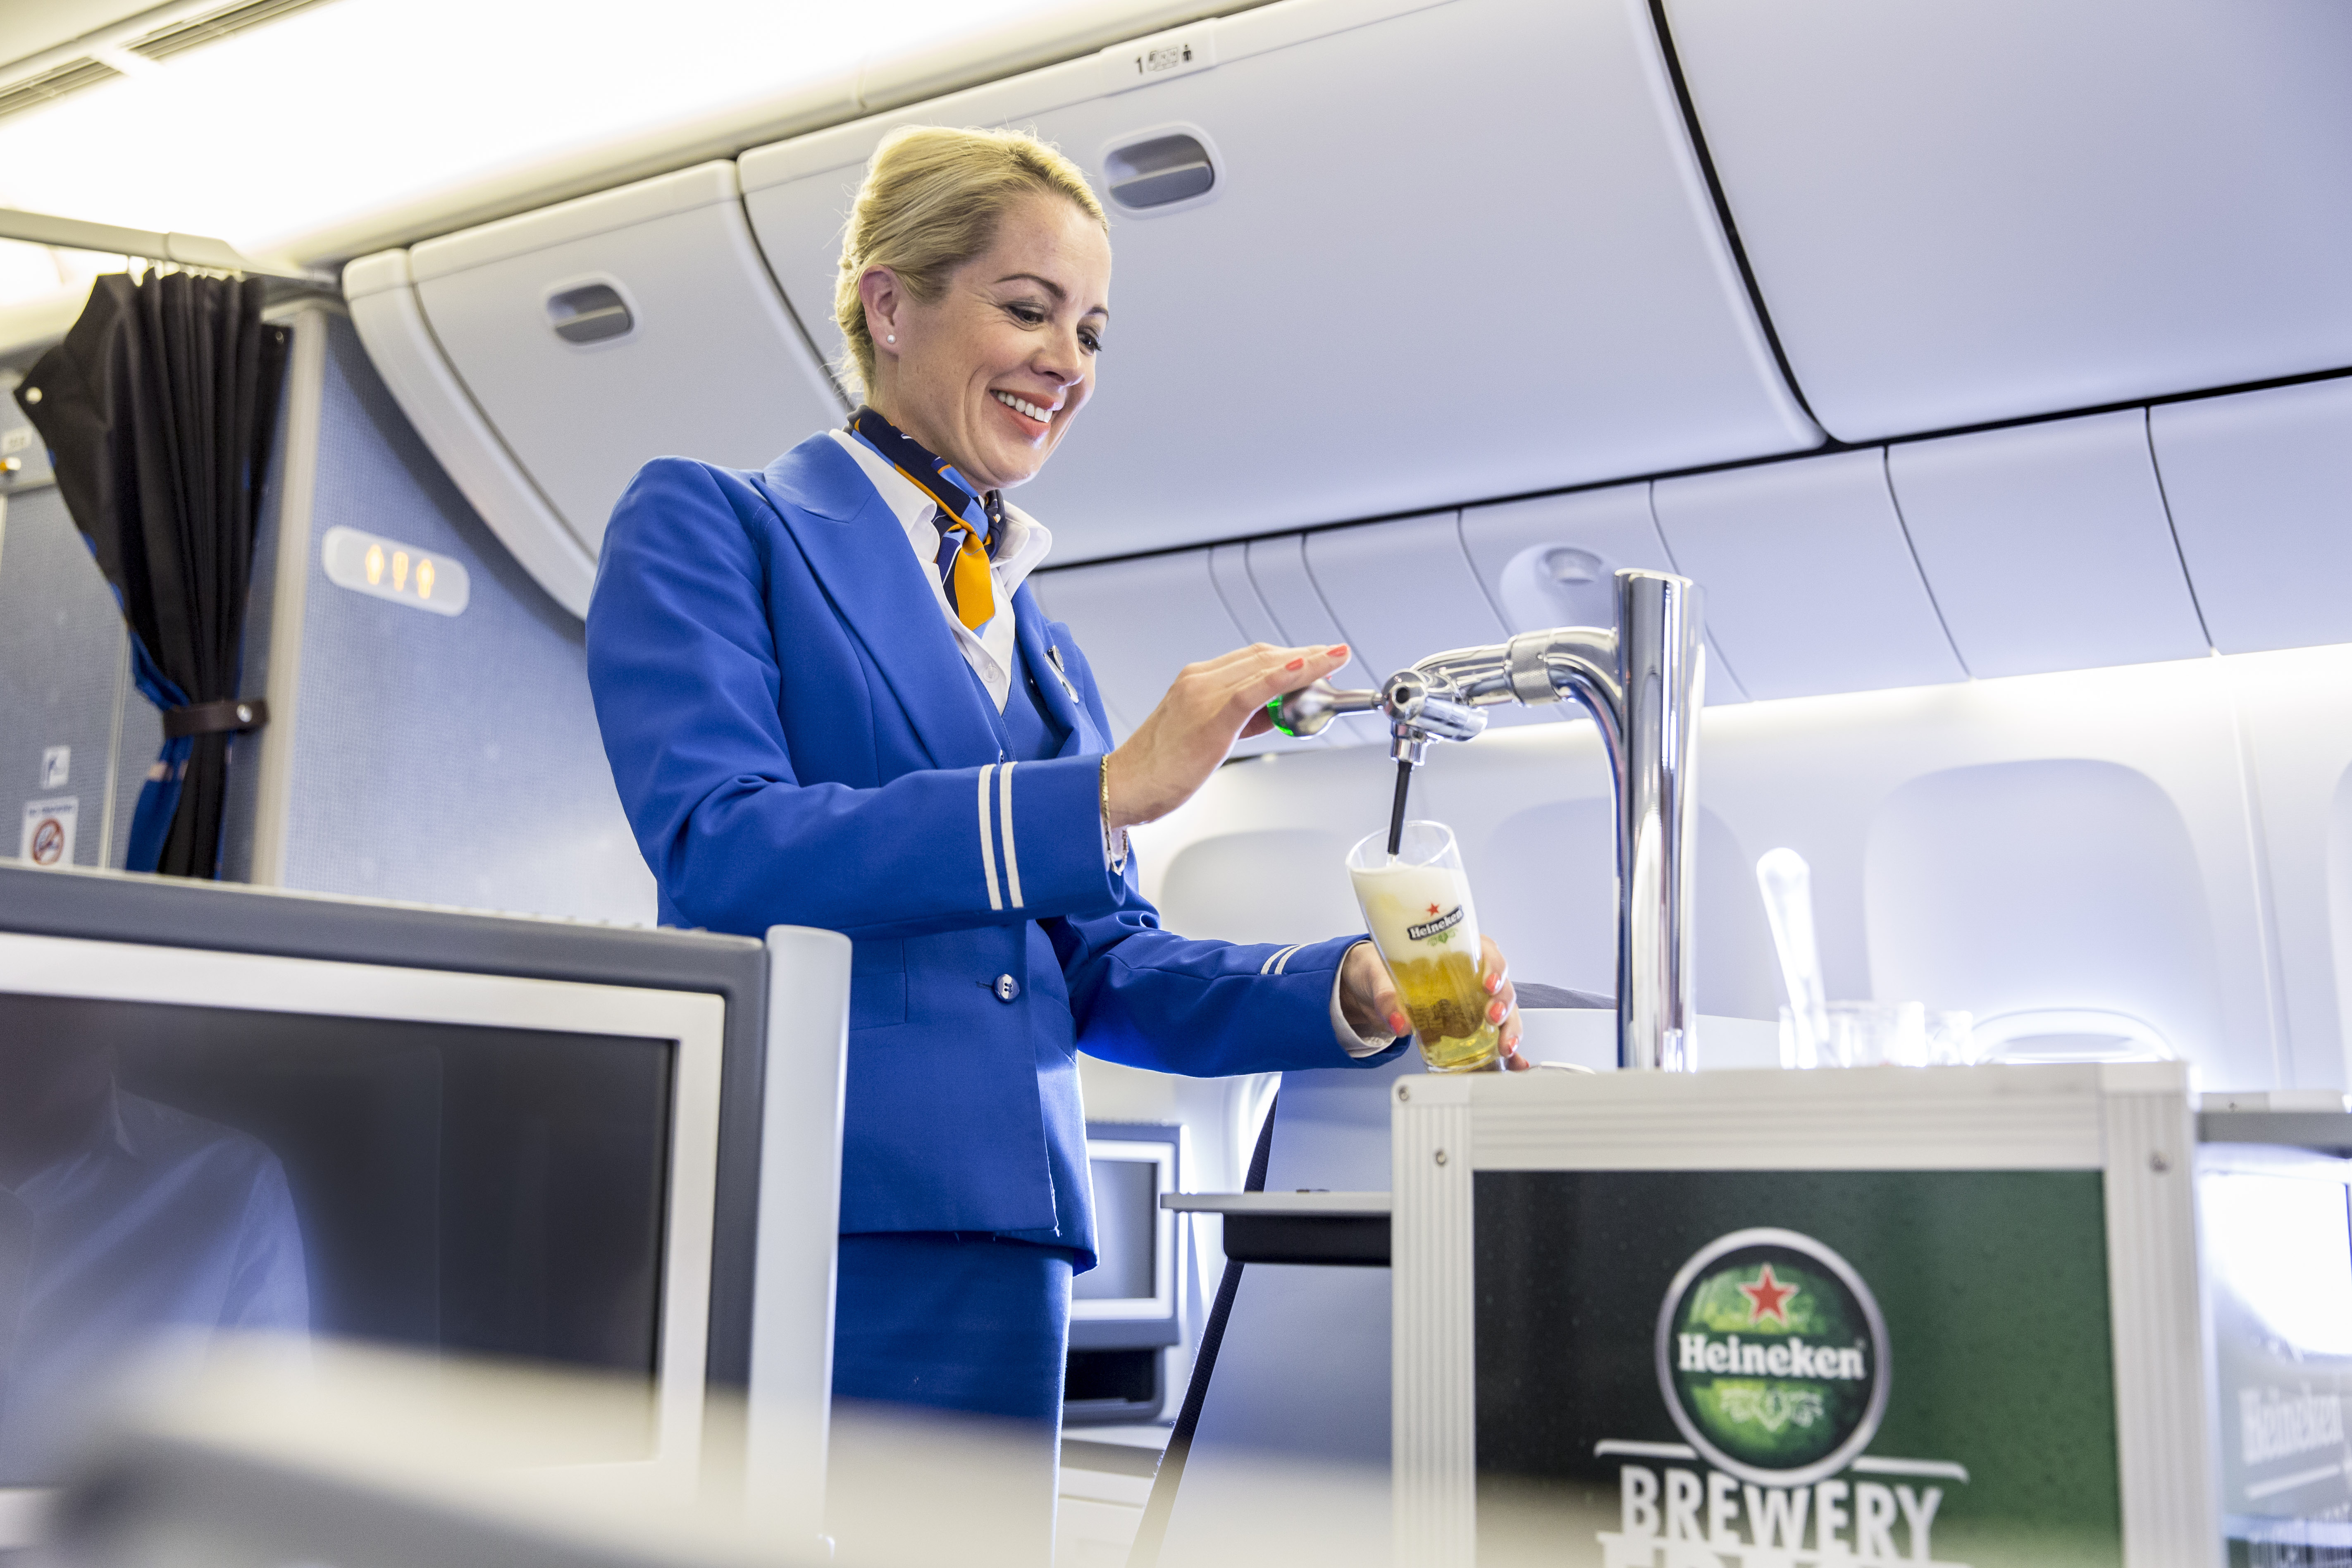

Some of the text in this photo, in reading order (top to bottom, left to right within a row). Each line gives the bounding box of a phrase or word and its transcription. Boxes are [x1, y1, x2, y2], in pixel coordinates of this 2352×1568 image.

[1410, 910, 1462, 938] Heineken
[1678, 1332, 1866, 1380] Heineken
[1620, 1466, 1944, 1561] BREWERY
